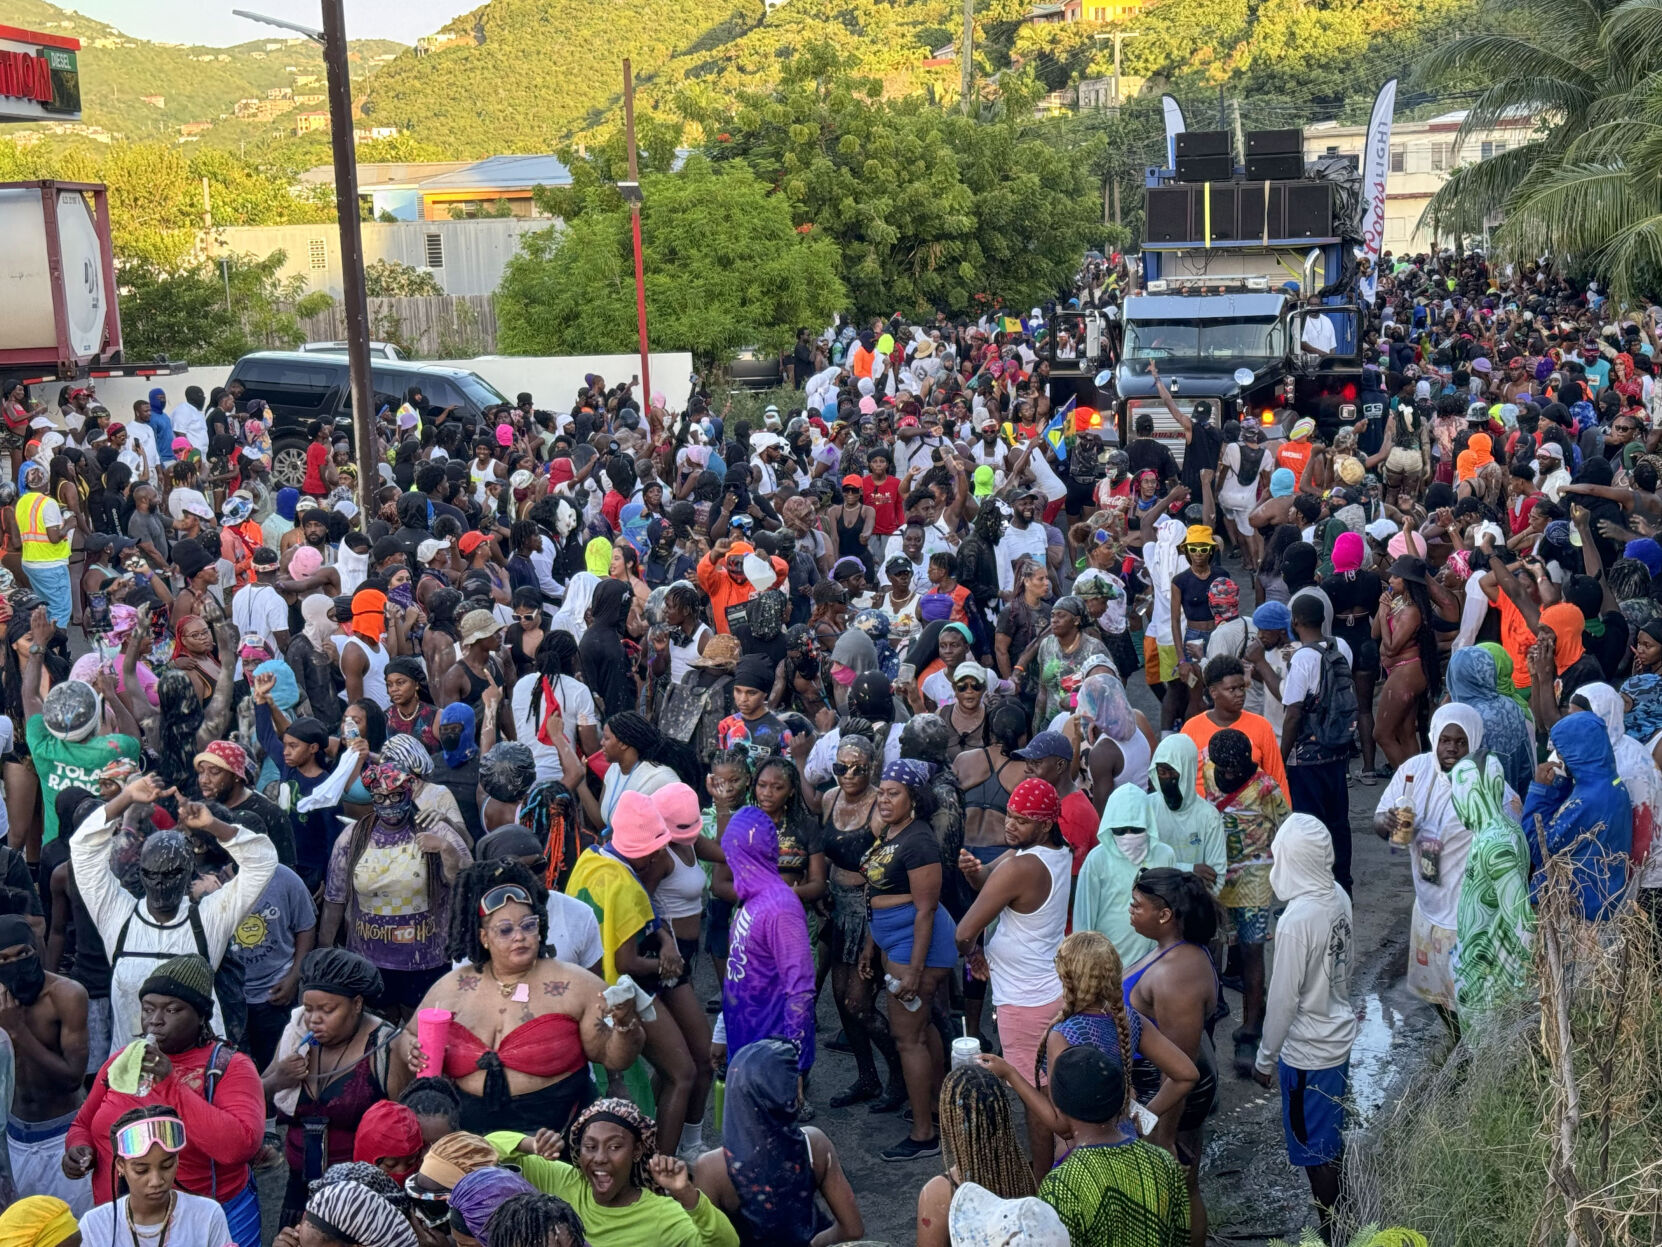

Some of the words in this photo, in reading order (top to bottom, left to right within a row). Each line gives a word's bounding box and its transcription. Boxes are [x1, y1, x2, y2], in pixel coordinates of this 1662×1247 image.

[51, 52, 71, 69] DIESEL
[1363, 180, 1386, 256] Coors
[1375, 120, 1389, 178] LIGHT
[53, 761, 102, 781] TOLA
[394, 927, 415, 941] TO
